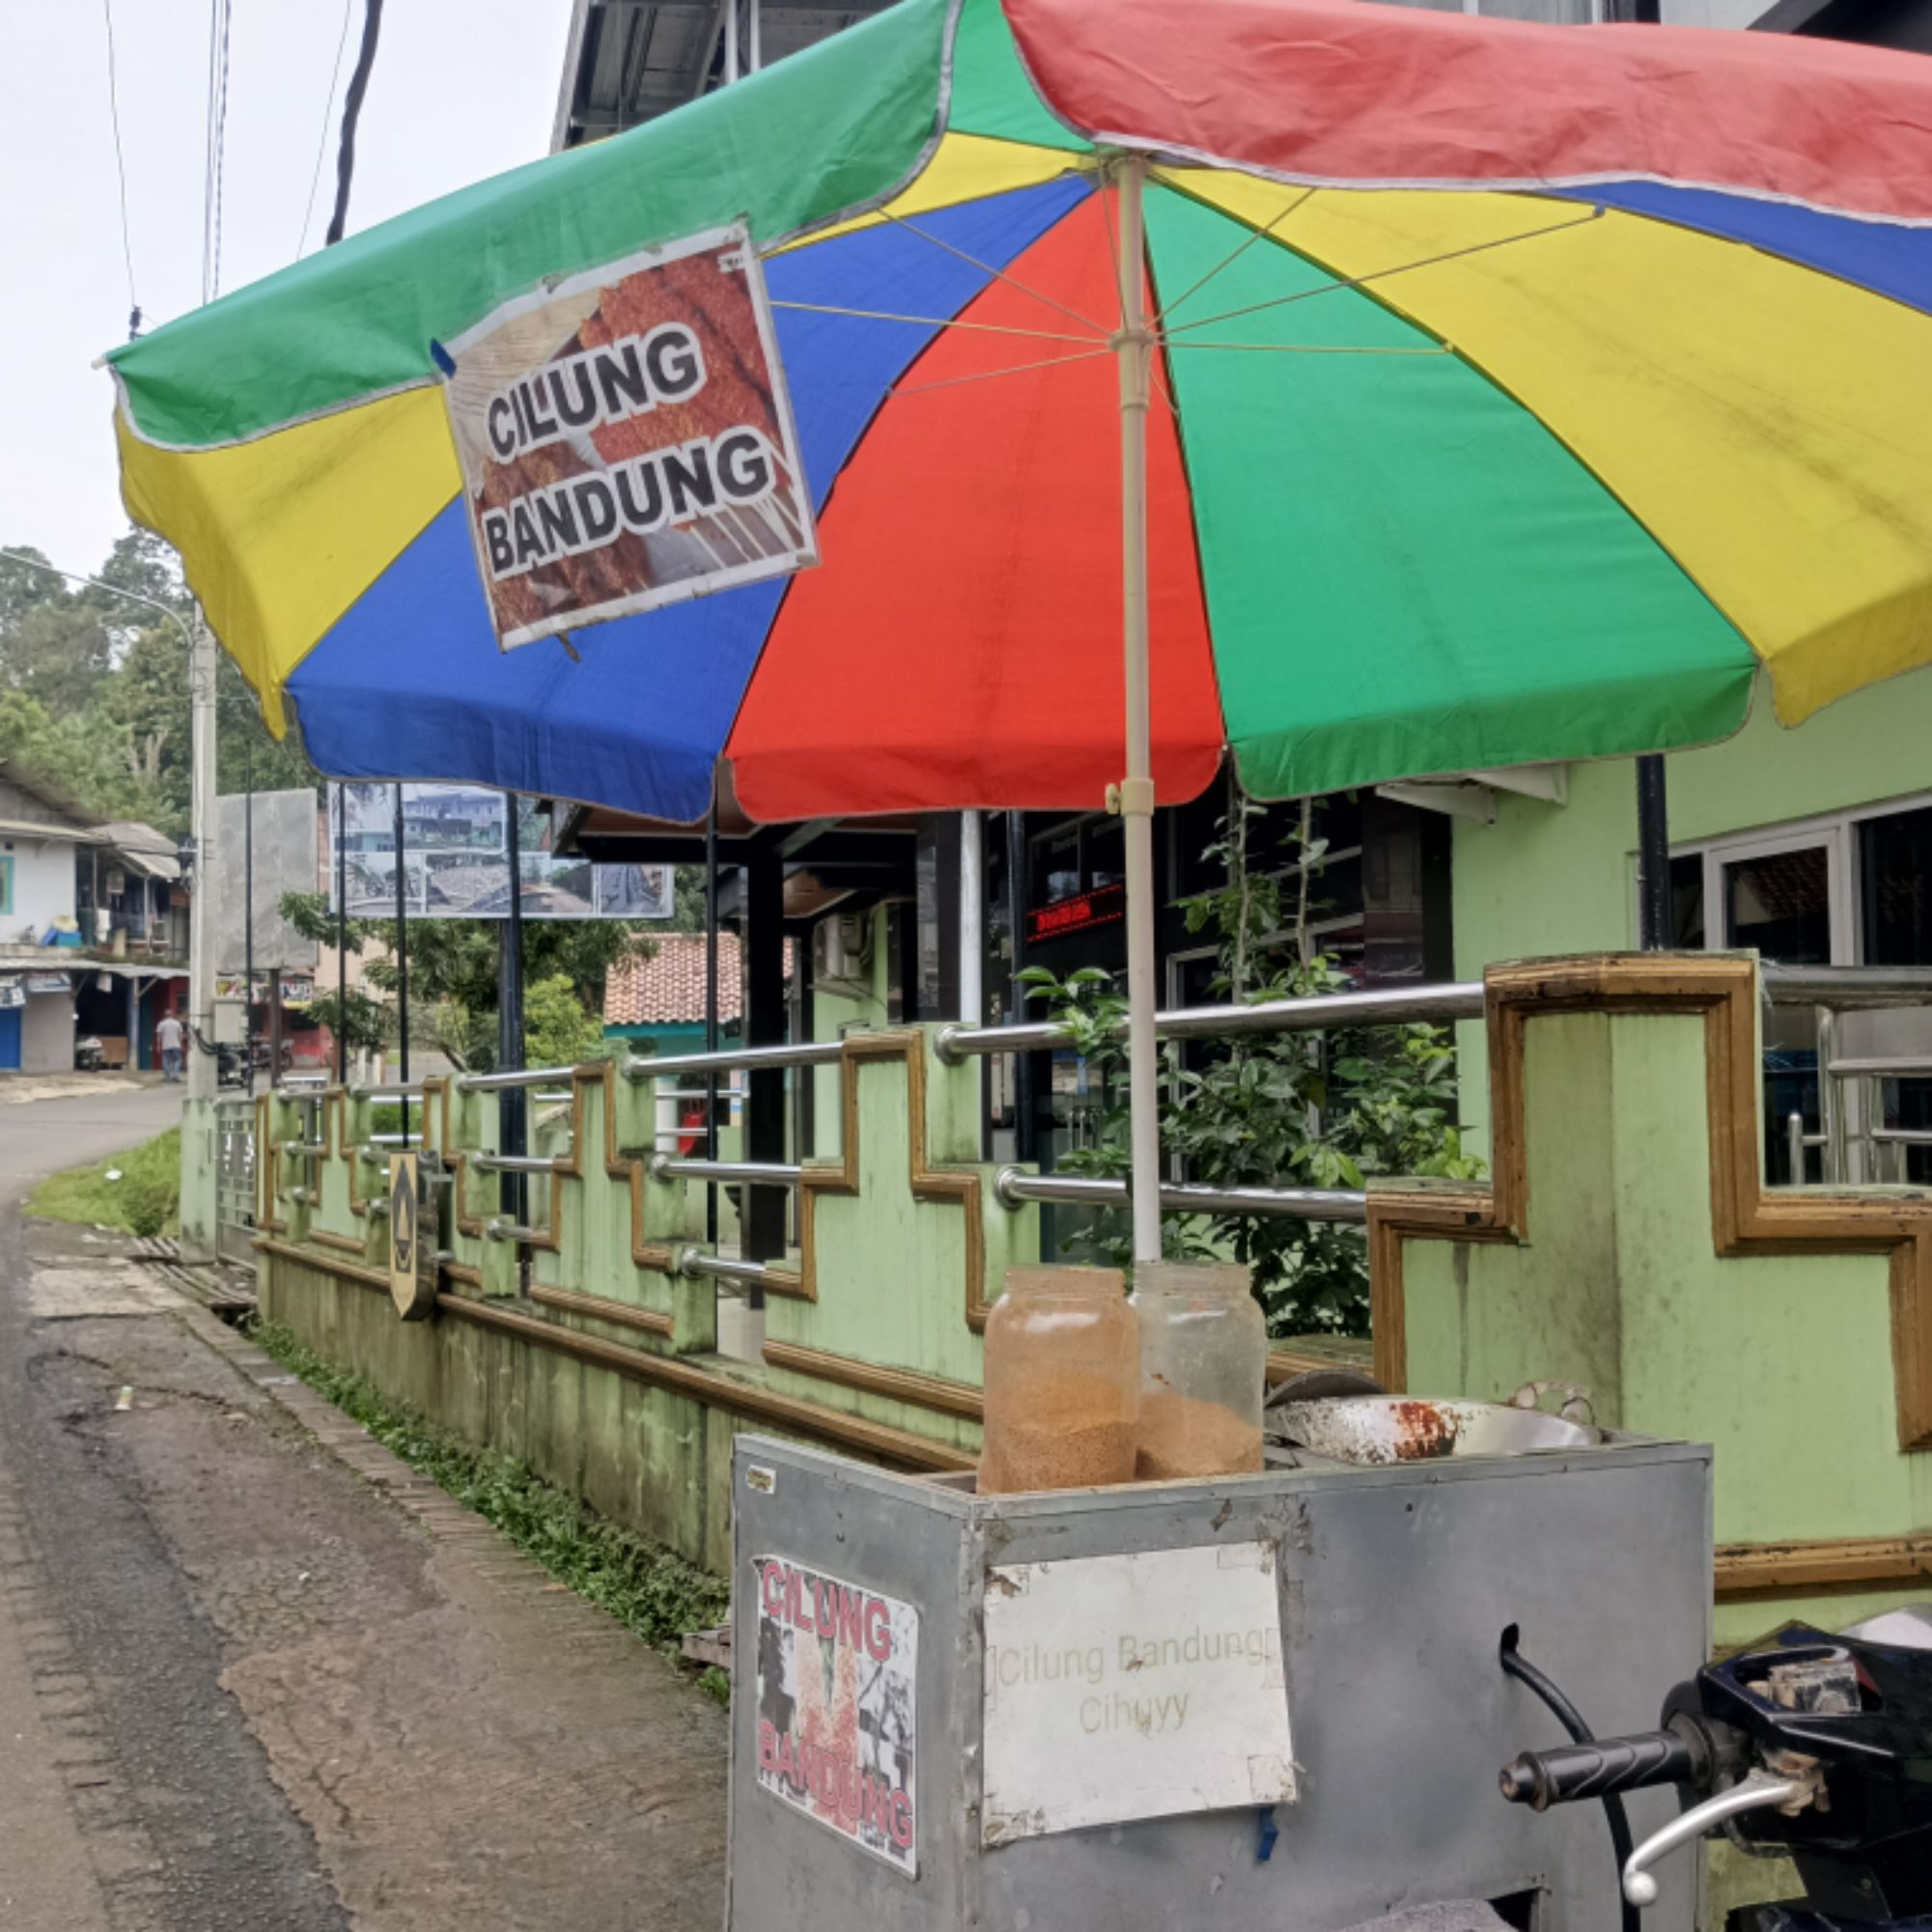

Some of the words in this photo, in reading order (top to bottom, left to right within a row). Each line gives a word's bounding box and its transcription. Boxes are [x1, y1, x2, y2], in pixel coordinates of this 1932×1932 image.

[489, 329, 700, 458] CILUNG
[486, 434, 770, 574] BANDUNG
[762, 1560, 892, 1663] CILUNG
[997, 1644, 1105, 1687] Cilung
[1117, 1625, 1264, 1672] Bandung
[1078, 1692, 1190, 1735] Cihuyy
[759, 1720, 914, 1850] BANDUNG
